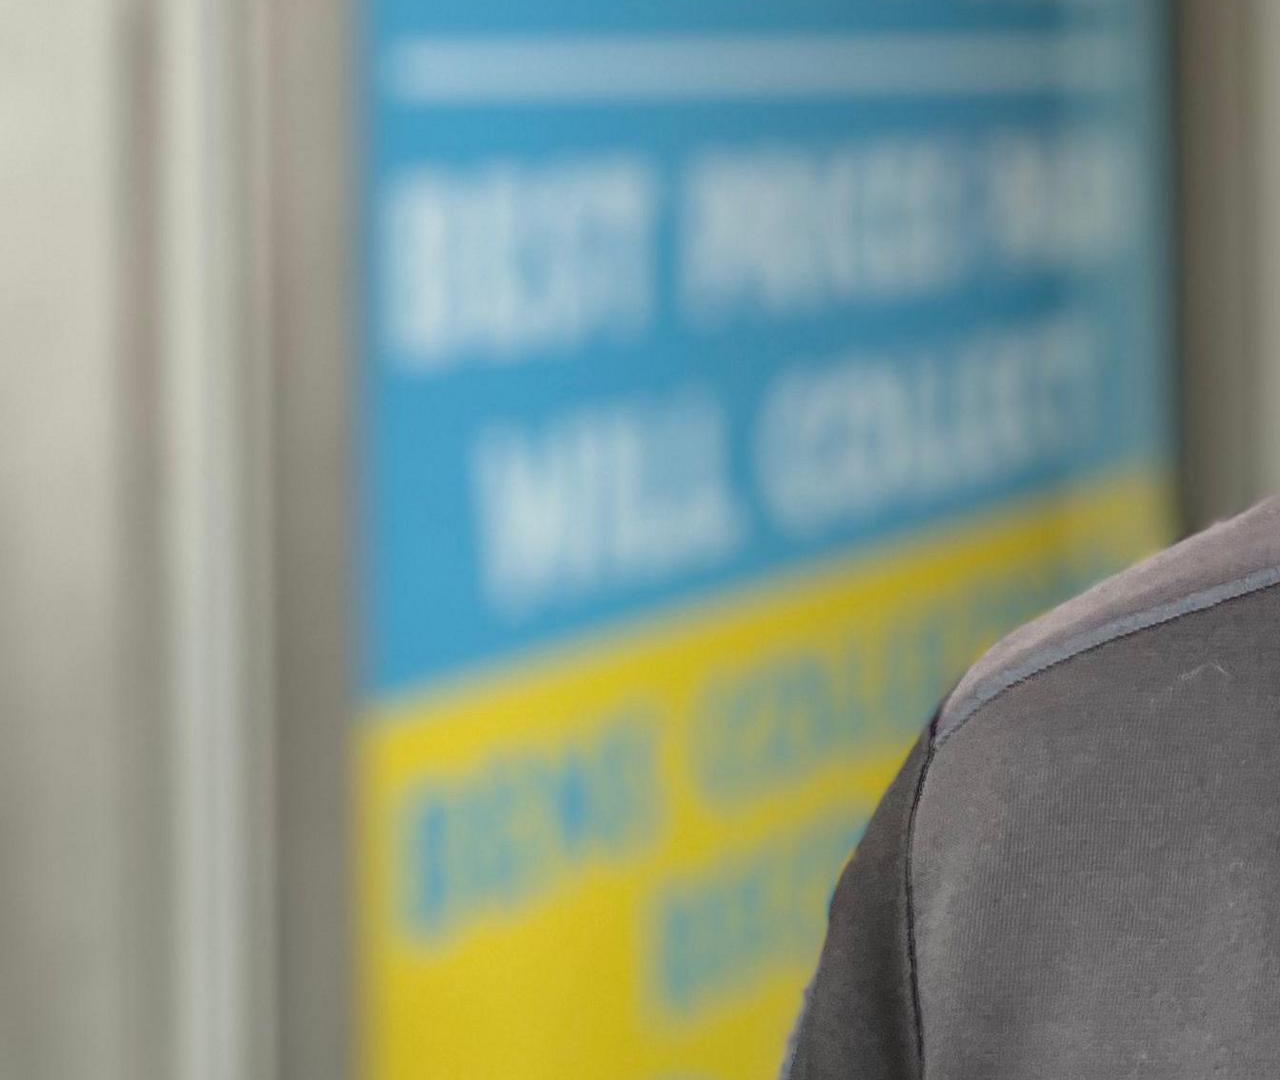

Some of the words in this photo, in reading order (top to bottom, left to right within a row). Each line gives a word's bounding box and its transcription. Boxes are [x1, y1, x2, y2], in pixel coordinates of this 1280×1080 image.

[388, 162, 654, 366] BEST
[478, 392, 742, 610] WILL
[758, 318, 1098, 526] COLLECT
